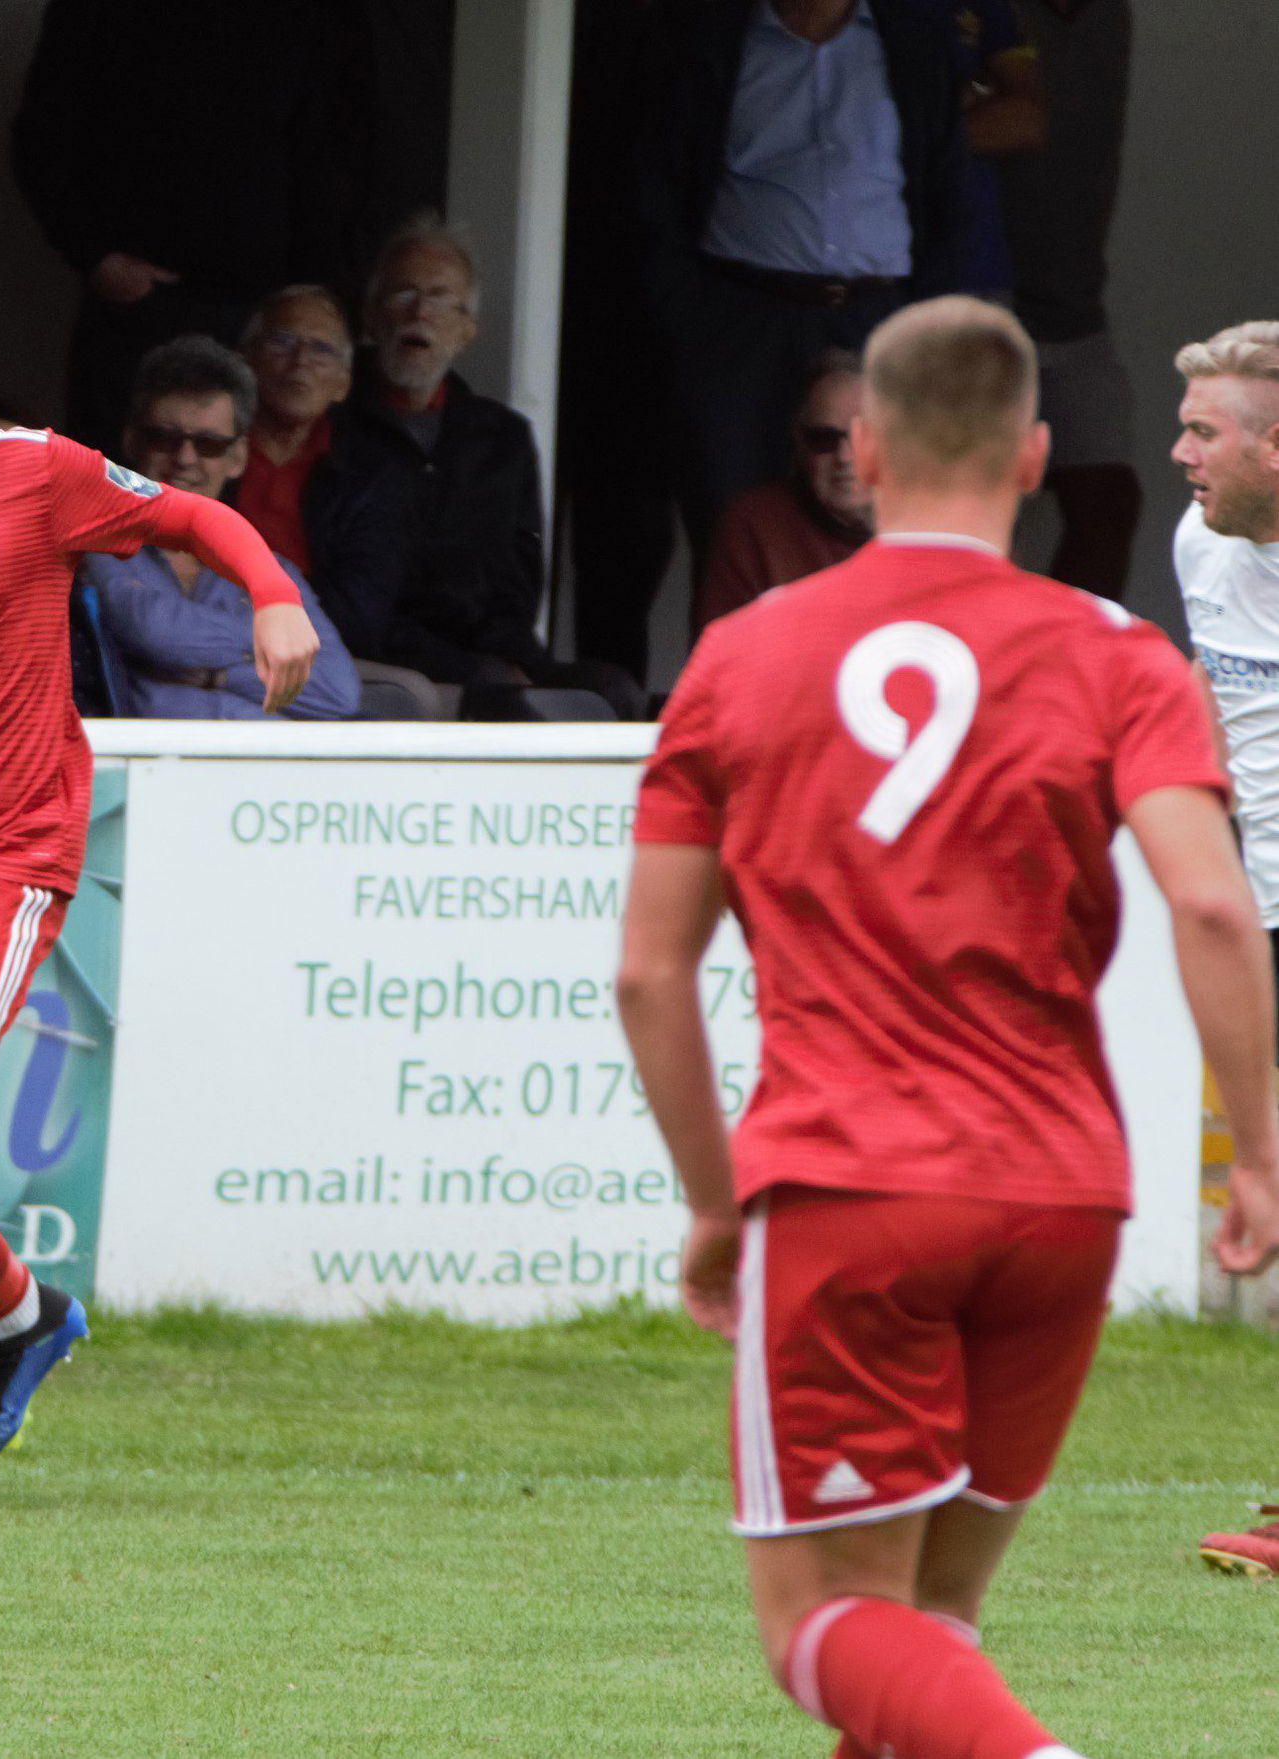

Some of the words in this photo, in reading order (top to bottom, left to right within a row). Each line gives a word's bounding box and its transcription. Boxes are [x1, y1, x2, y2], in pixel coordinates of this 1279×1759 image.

[835, 619, 981, 846] 9
[230, 800, 454, 846] OSPRINGE
[296, 959, 612, 1034] Telephone:
[397, 1060, 503, 1116] Fax:
[520, 1061, 651, 1118] 0179
[215, 1155, 400, 1205] email:
